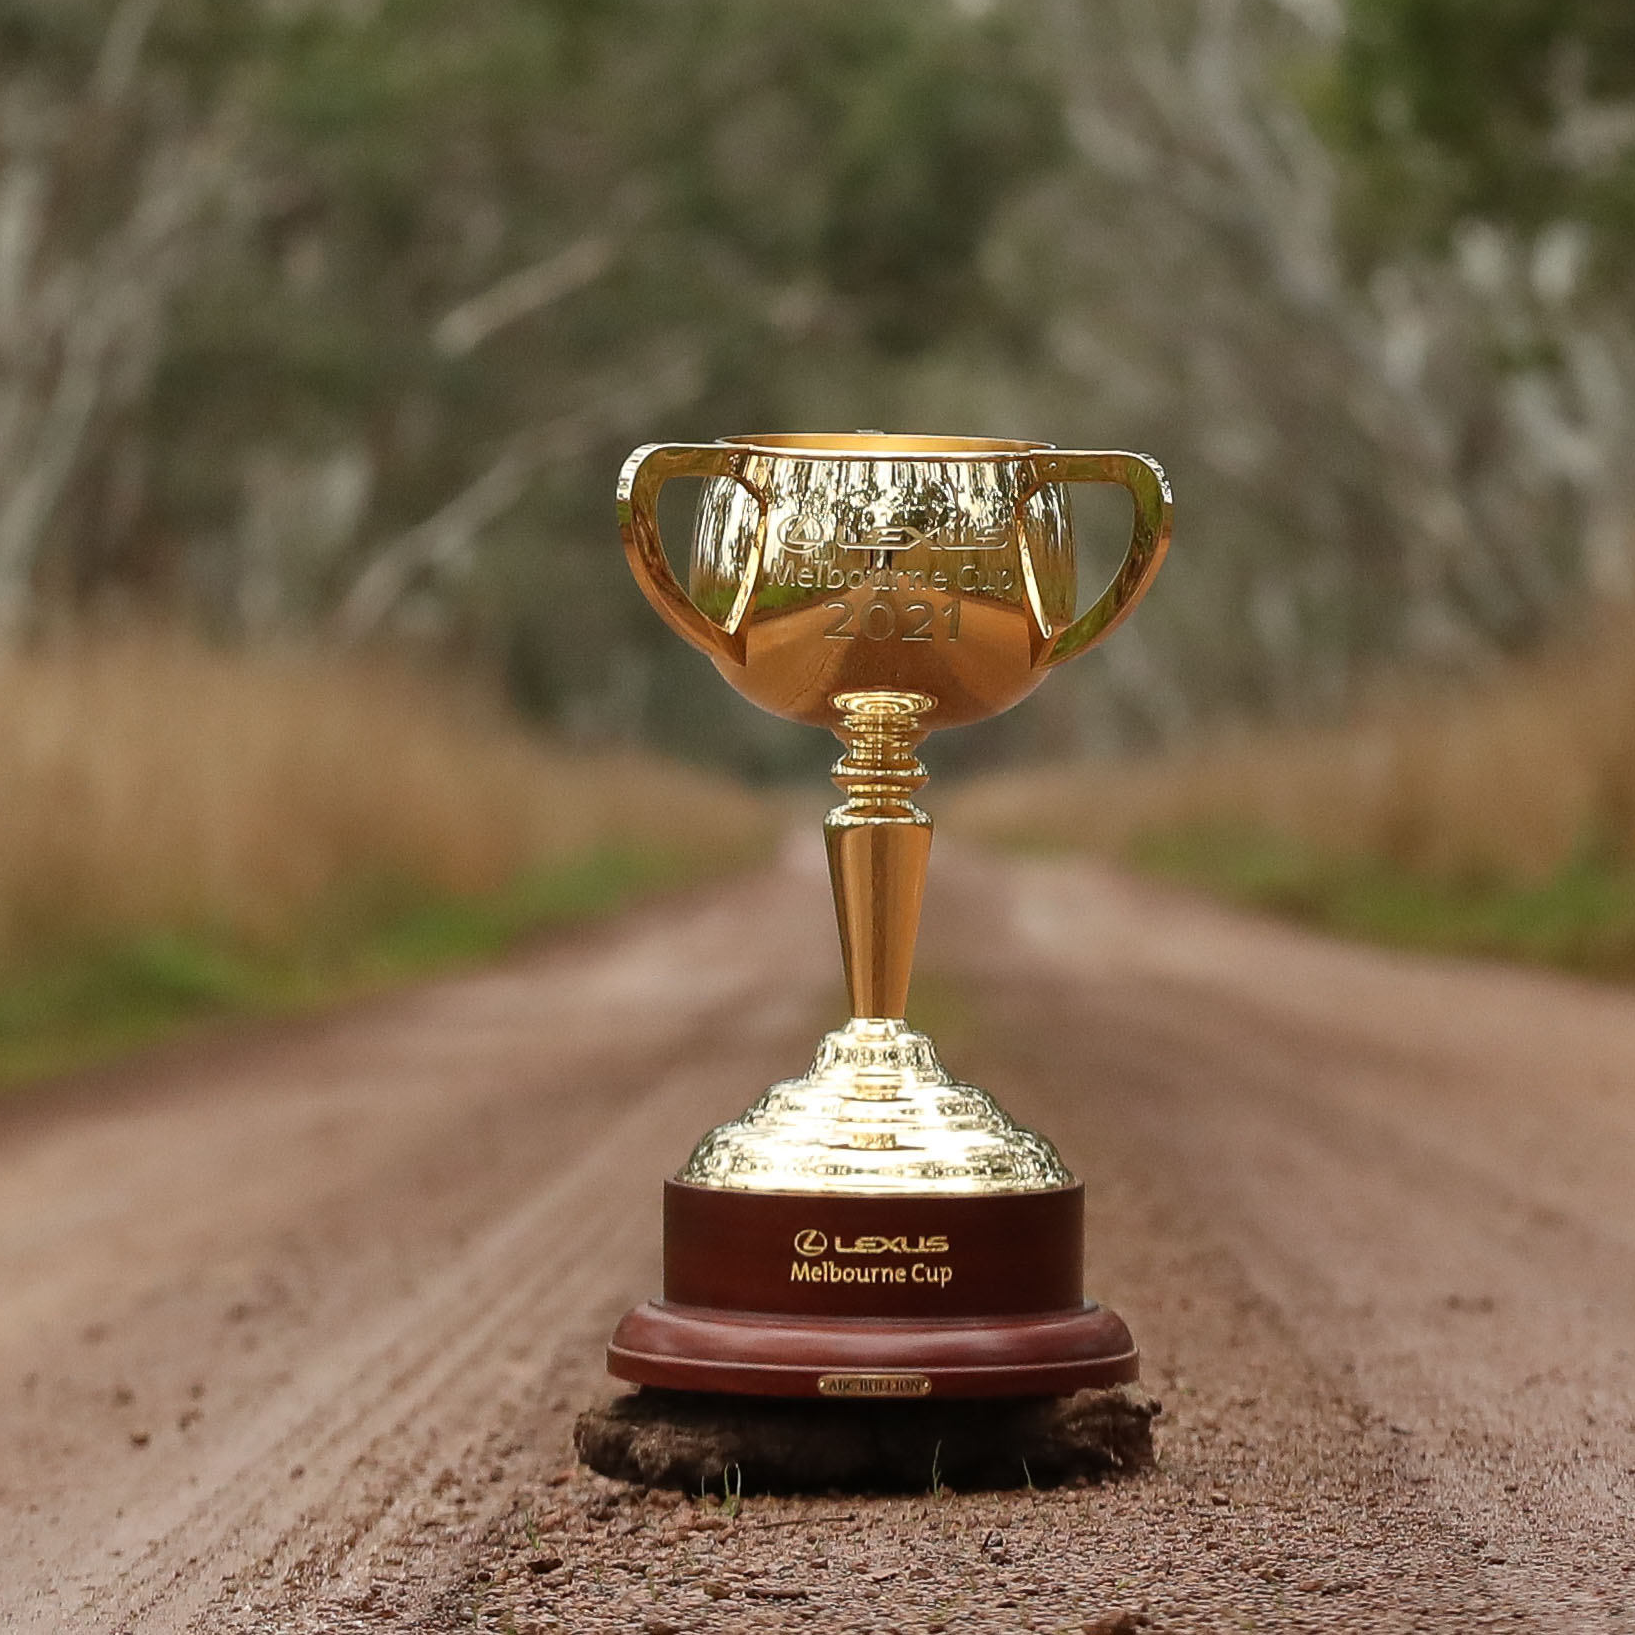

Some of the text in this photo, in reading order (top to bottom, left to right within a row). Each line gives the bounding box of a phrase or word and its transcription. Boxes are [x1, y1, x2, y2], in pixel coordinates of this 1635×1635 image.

[838, 525, 1008, 551] LEXUS
[767, 559, 1013, 593] Melbourne Cup
[823, 600, 961, 641] 2021
[834, 1236, 949, 1253] LEXUS
[791, 1261, 953, 1288] Melbourne Cup
[860, 1379, 920, 1392] BULLION
